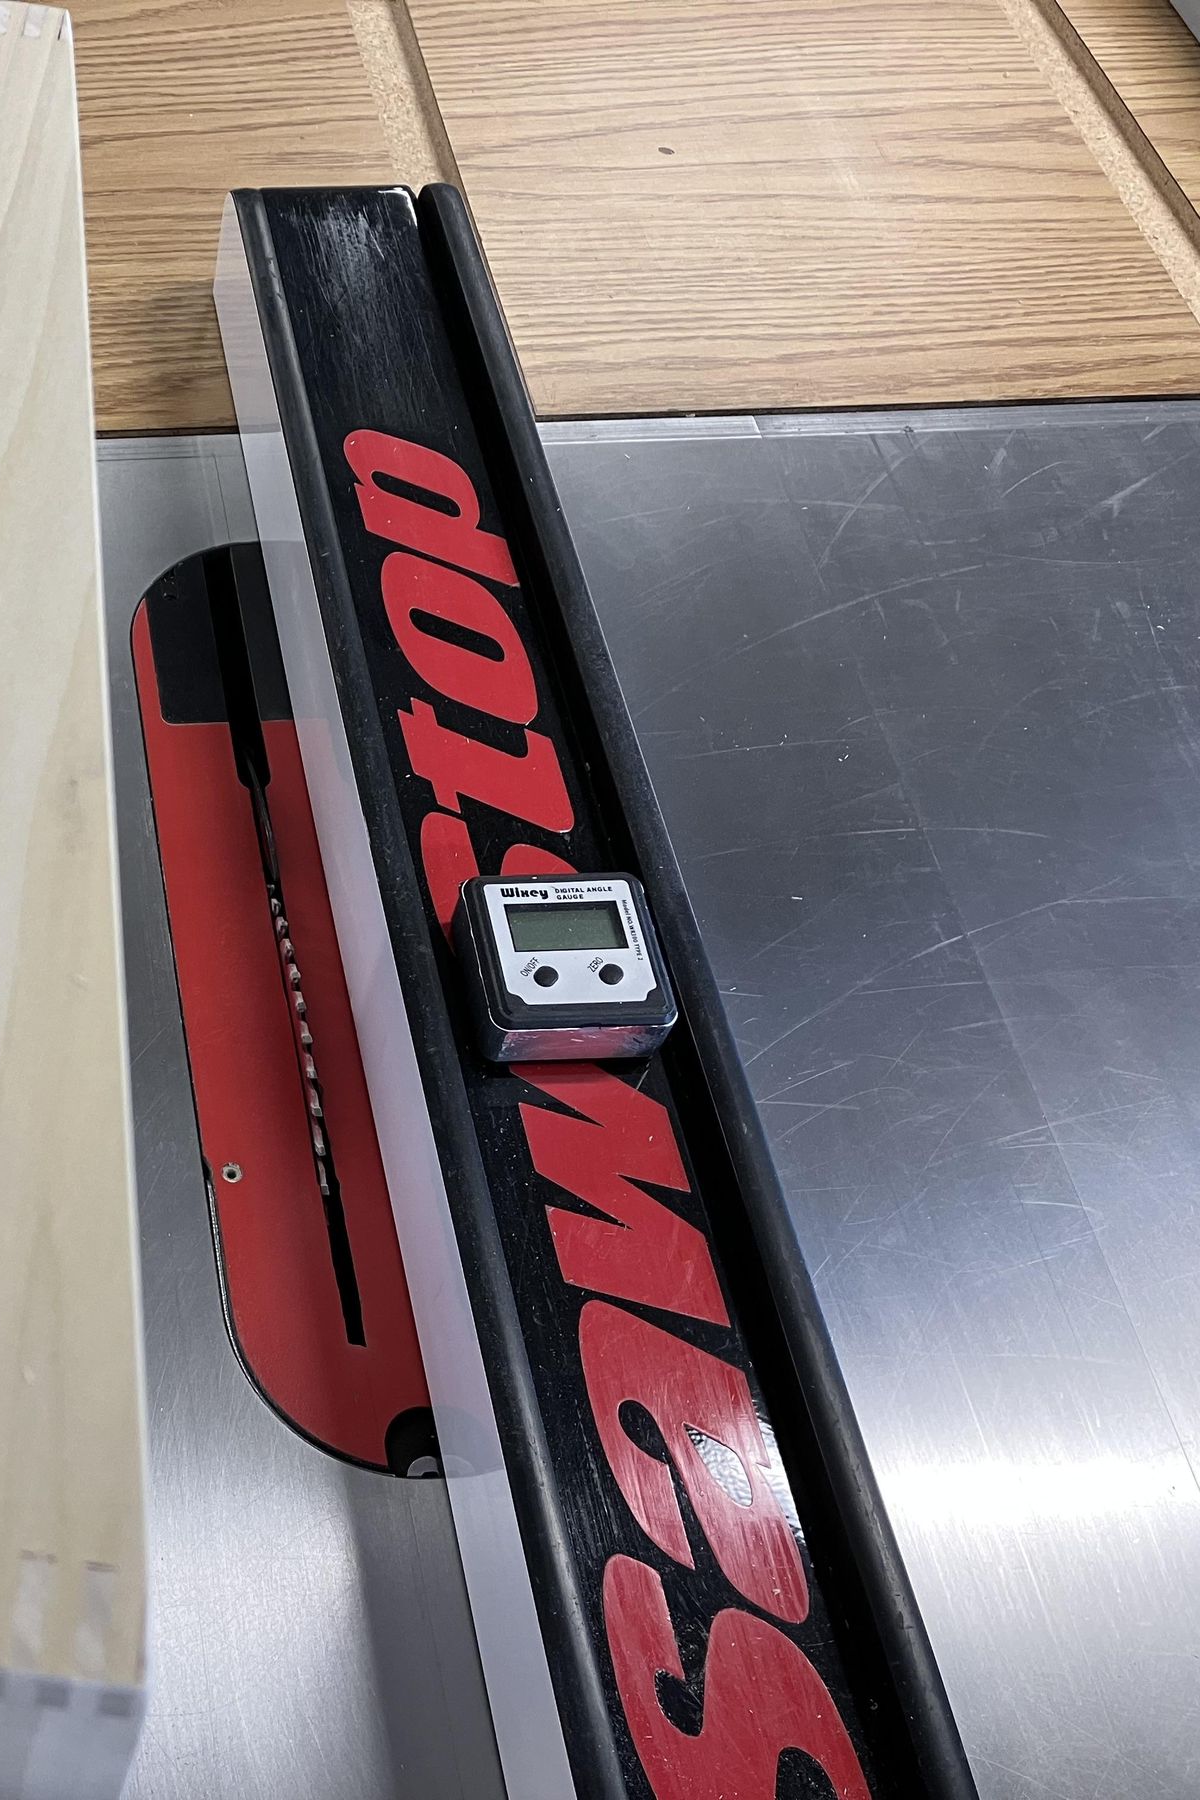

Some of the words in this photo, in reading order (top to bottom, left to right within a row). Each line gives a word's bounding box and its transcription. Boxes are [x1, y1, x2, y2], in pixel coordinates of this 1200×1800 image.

[500, 887, 548, 899] Wixey
[622, 899, 632, 915] Model
[634, 944, 642, 956] TYPE
[520, 957, 539, 976] ON/OFF
[587, 957, 603, 972] ZERO
